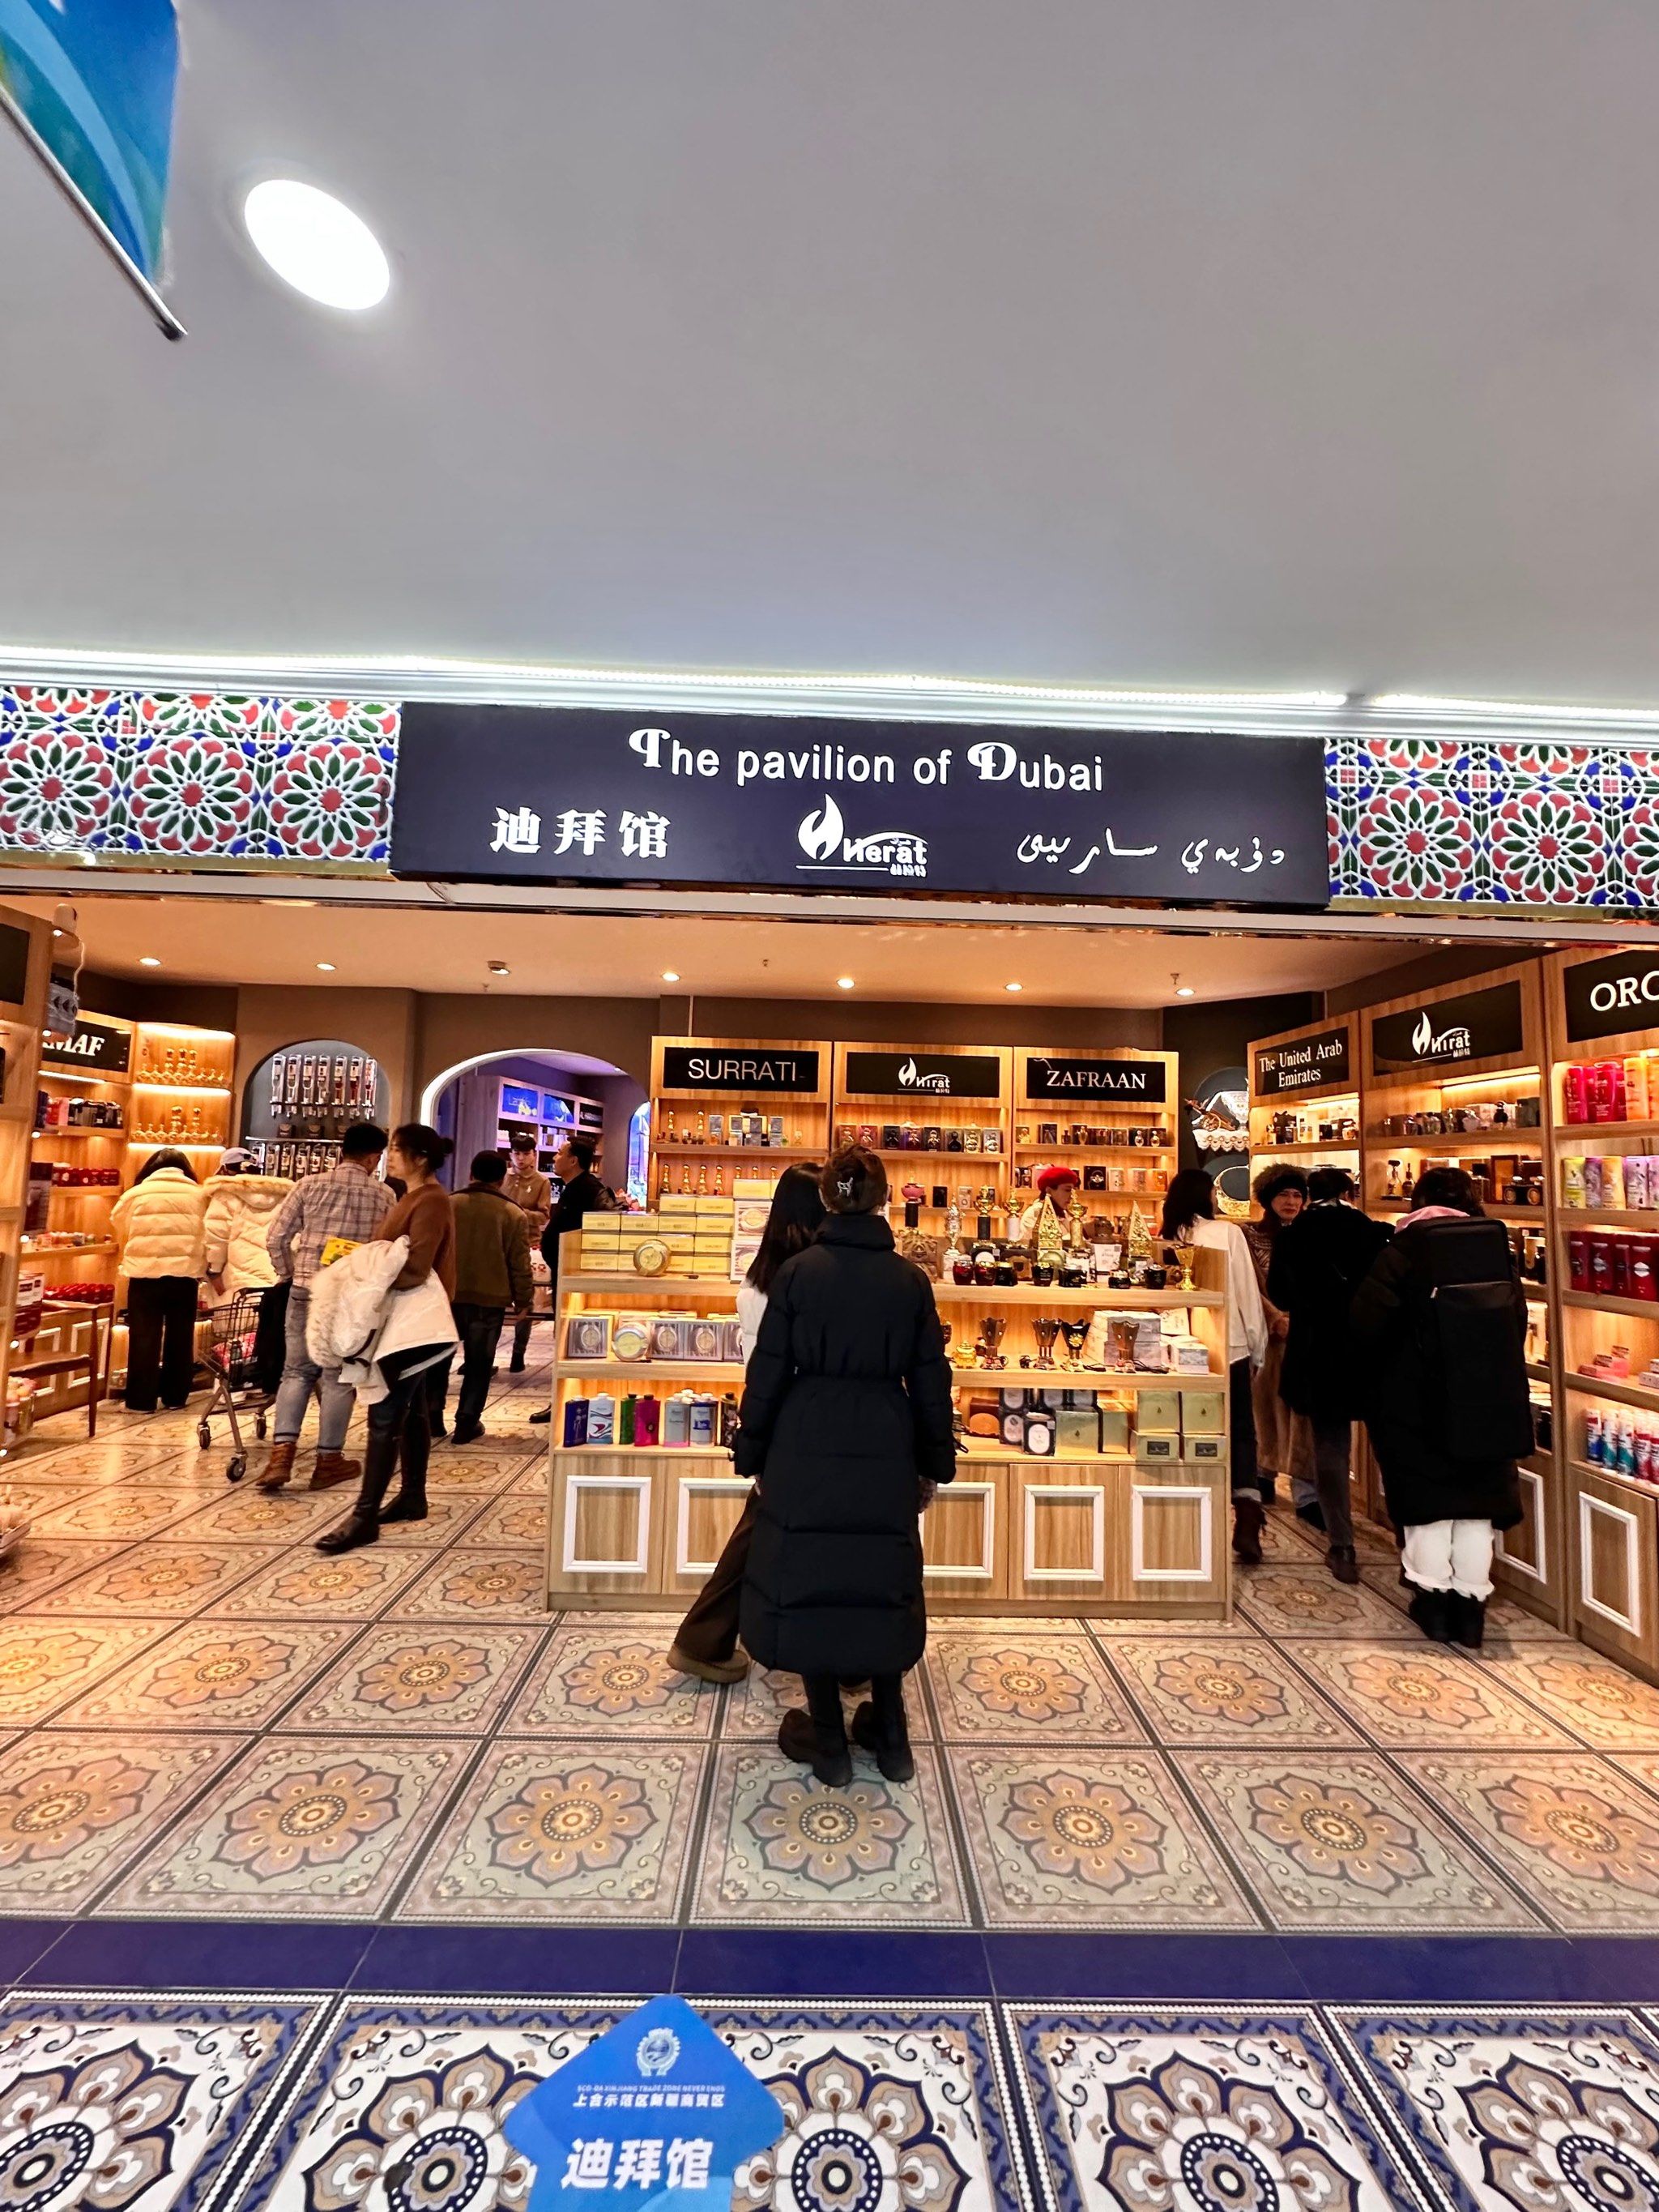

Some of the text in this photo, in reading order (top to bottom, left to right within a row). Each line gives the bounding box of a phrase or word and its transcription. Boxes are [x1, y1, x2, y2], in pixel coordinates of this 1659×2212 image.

[629, 728, 1102, 791] The pavilion of Dubai
[489, 806, 671, 859] 迪拜馆
[42, 1033, 105, 1057] MAF
[1259, 1039, 1342, 1073] The United Arab
[688, 1058, 795, 1082] SURRATI
[1047, 1070, 1146, 1089] ZAFRAAN
[1278, 1069, 1321, 1087] Emirates
[561, 2137, 714, 2191] 迪拜馆
